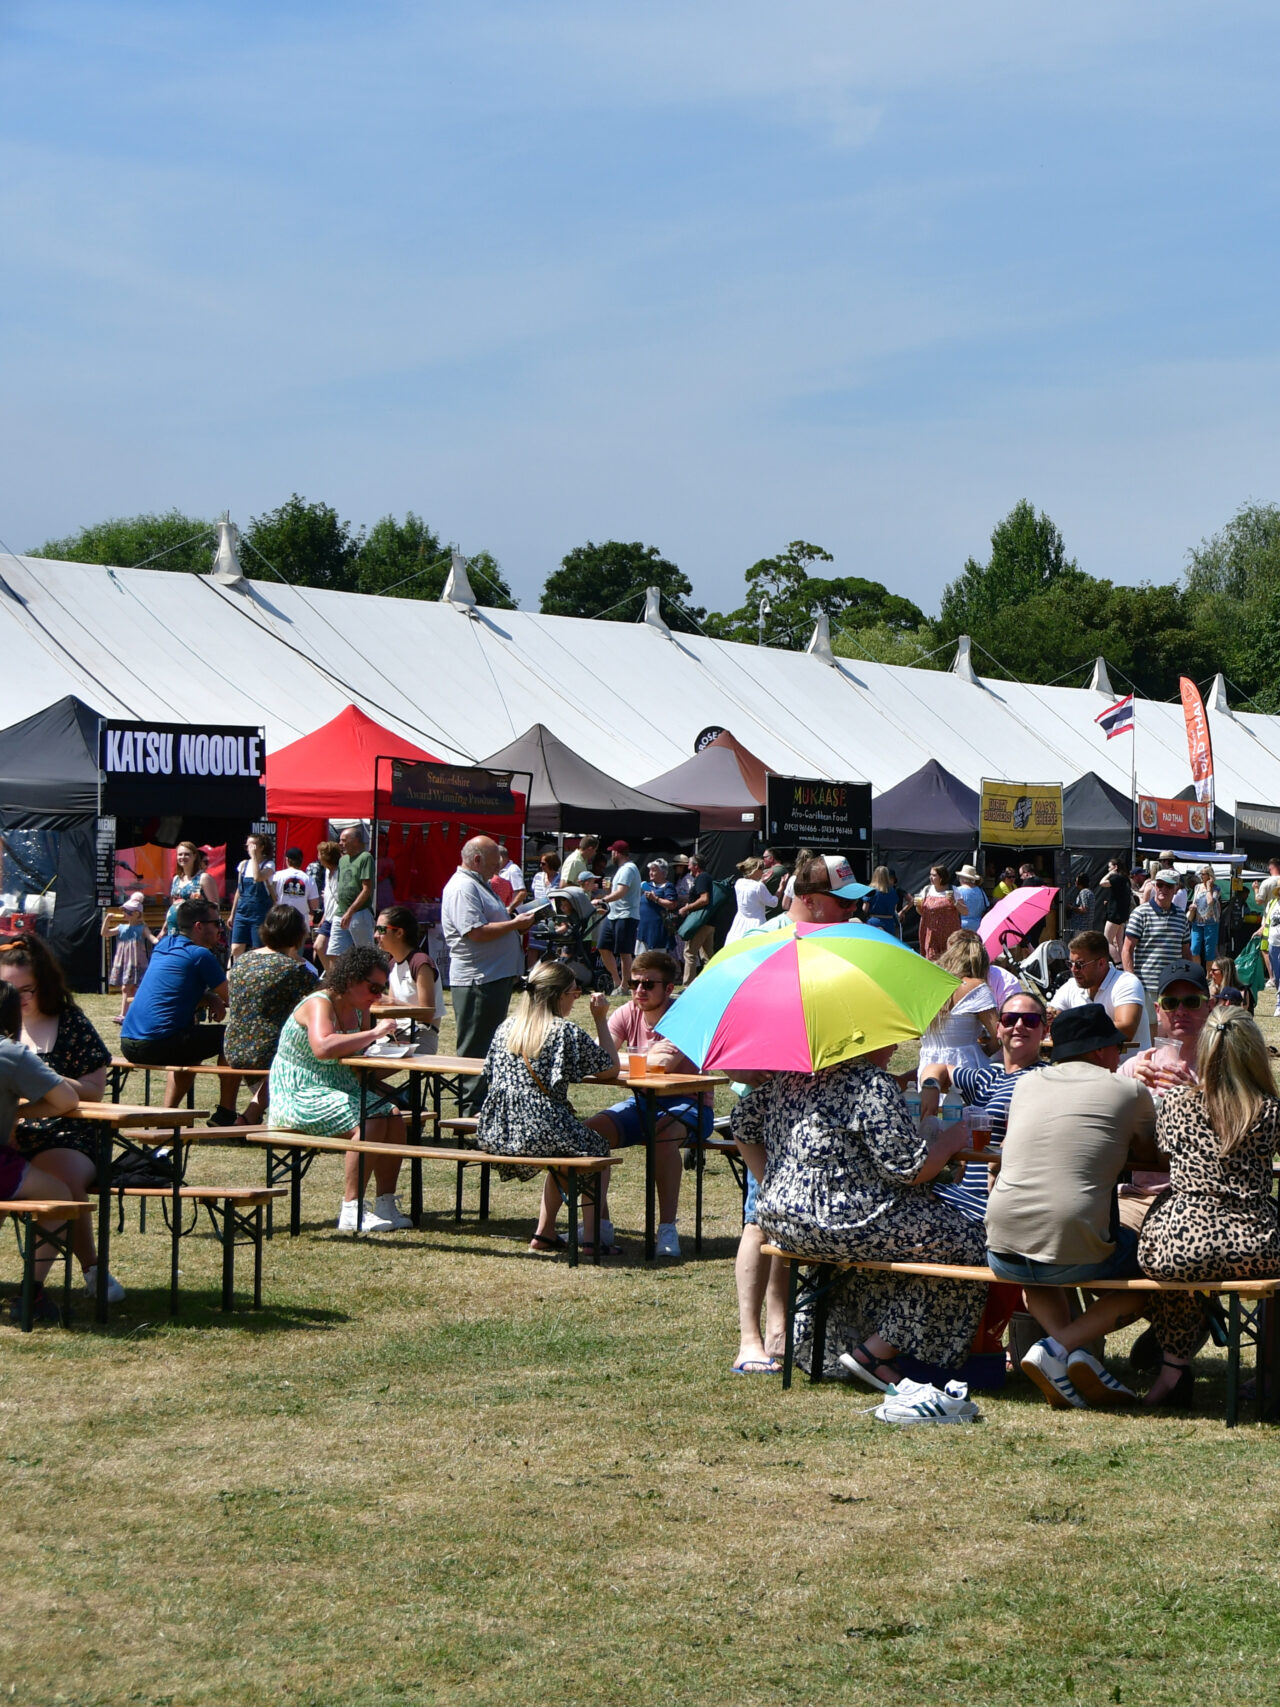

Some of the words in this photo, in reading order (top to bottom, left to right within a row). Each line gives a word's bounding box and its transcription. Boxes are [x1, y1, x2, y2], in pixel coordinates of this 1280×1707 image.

[1193, 701, 1205, 739] THAI
[698, 731, 720, 751] ROSE
[106, 730, 174, 775] KATSU
[179, 734, 261, 777] NOODLE
[1198, 742, 1208, 773] PAD
[793, 786, 847, 807] MUKAASE
[98, 818, 117, 831] MENU
[252, 822, 276, 835] MENU
